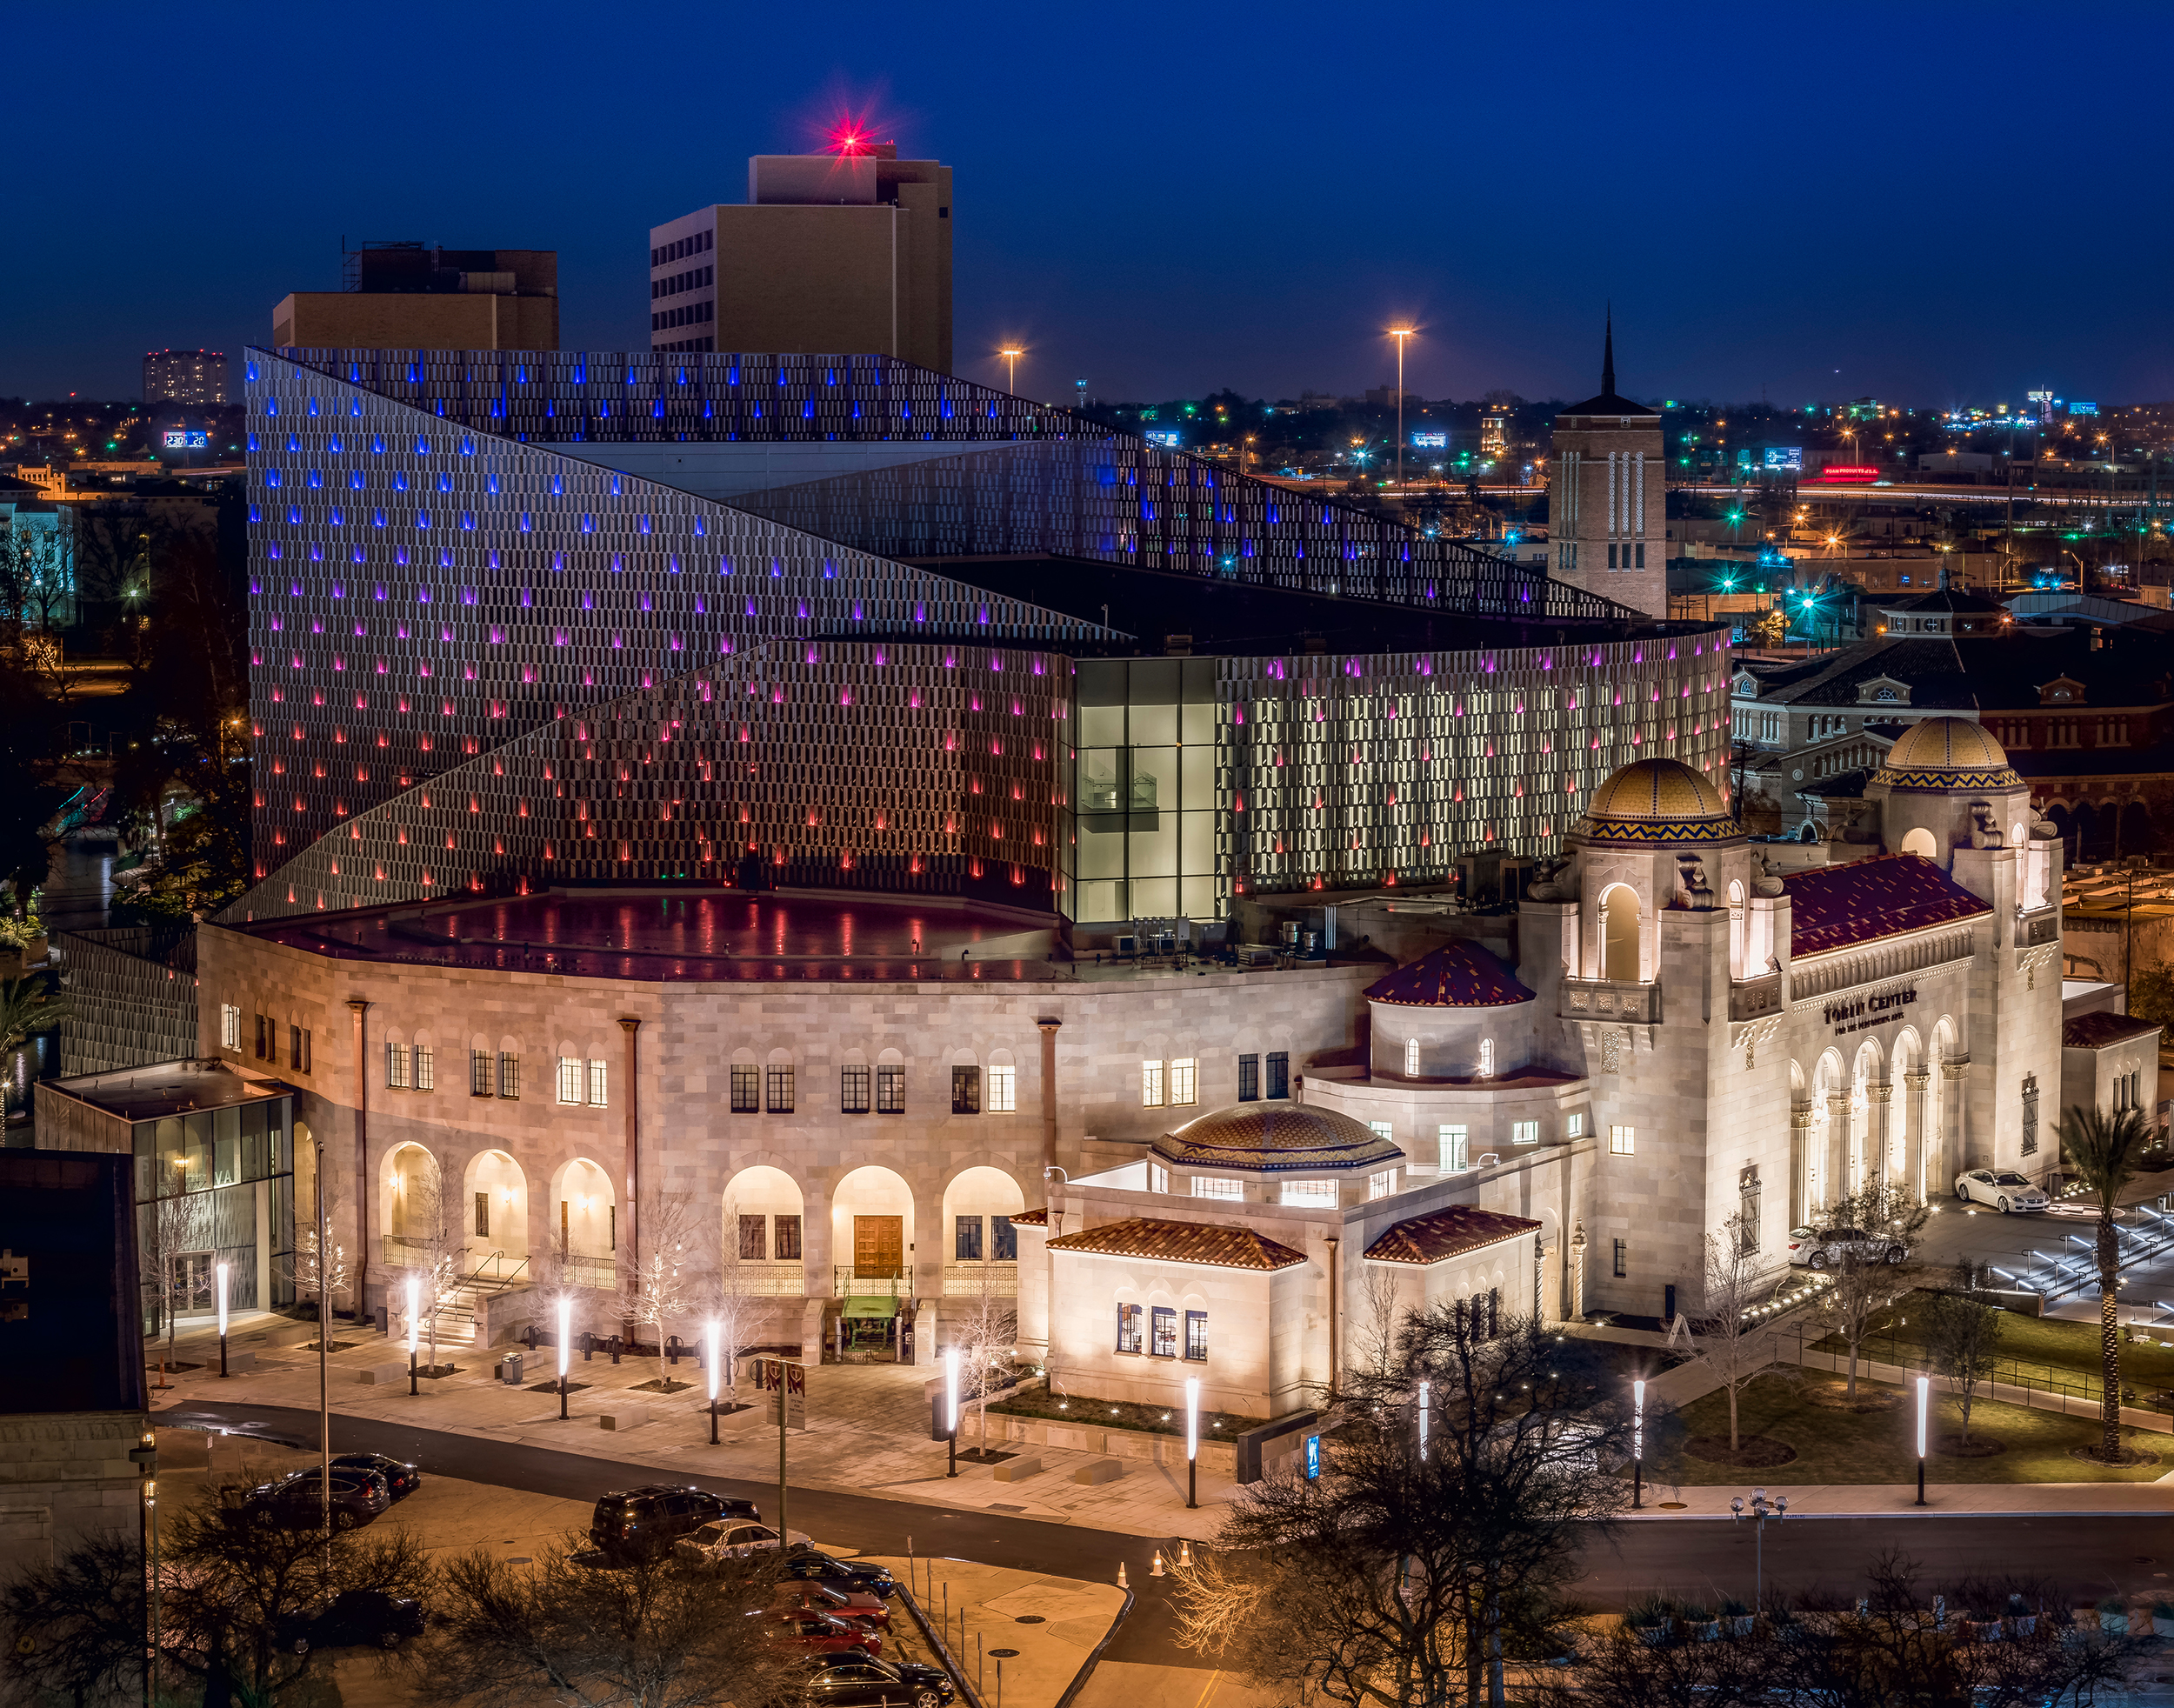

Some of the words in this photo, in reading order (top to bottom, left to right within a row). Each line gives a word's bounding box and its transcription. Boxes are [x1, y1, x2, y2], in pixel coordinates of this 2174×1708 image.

[193, 437, 204, 445] 20
[1824, 1003, 1865, 1024] TOBIN
[1869, 991, 1917, 1012] CENTER
[1847, 1024, 1857, 1033] THE
[1891, 1011, 1904, 1022] ARTS
